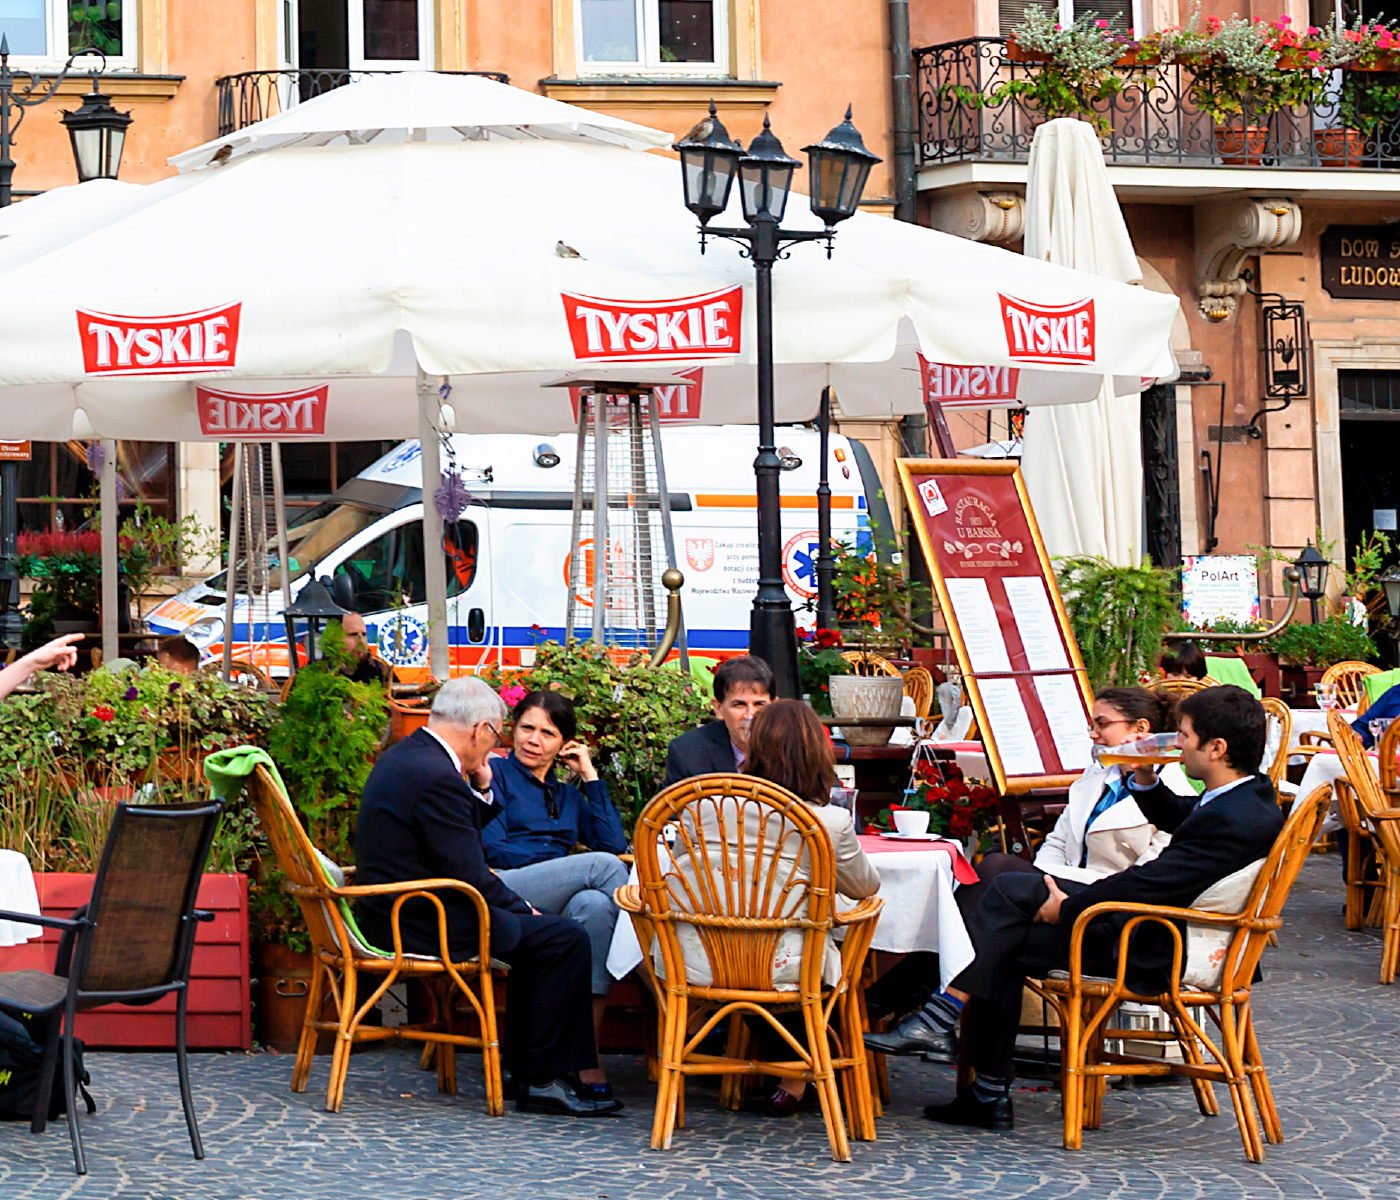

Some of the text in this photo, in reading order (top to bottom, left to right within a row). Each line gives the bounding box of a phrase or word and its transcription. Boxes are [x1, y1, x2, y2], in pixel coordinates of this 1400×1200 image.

[1341, 239, 1378, 258] DOM
[88, 315, 229, 366] TYSKIE
[575, 300, 733, 353] TYSKIE
[1006, 305, 1092, 356] TYSKIE
[955, 495, 997, 527] RESTAURACJA
[957, 527, 1002, 538] U BARSSA
[1201, 570, 1239, 581] PolArt
